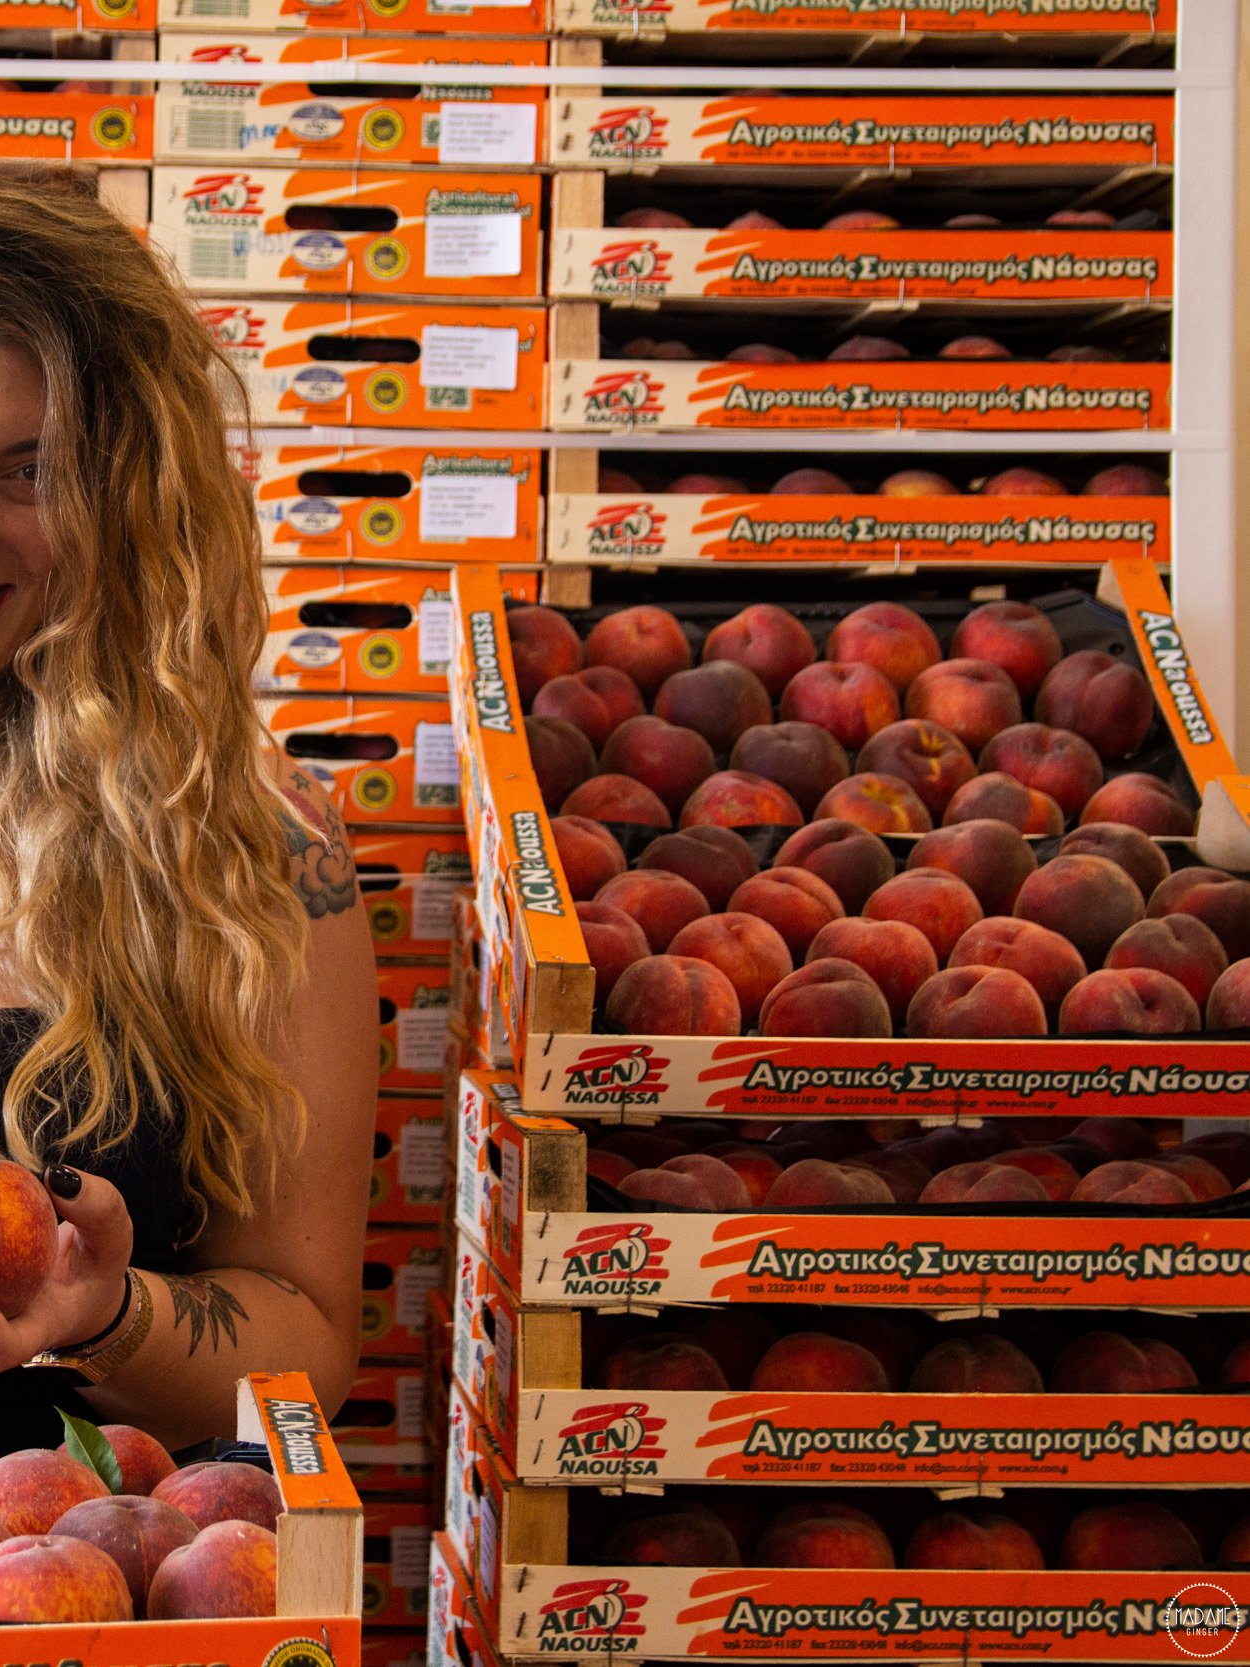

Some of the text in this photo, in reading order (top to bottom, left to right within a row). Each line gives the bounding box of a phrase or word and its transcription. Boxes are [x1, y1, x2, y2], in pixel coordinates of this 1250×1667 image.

[728, 117, 1154, 148] Αγροτικός Συνεταιρισμός Νάουσας
[733, 254, 1158, 284] Αγροτικός Συνεταιρισμός Νάουσας
[723, 385, 1150, 414] Αγροτικός Συνεταιρισμός Νάουσας
[728, 516, 1155, 546] Αγροτικός Συνεταιρισμός Νάουσας
[1137, 609, 1215, 745] ACNaoussa
[512, 810, 565, 916] ACNaoussa
[563, 1061, 635, 1092] ACN
[743, 1059, 904, 1095] Αγροτικός
[905, 1061, 1126, 1097] Συνεταιρισμός
[564, 1090, 660, 1105] NAOUSSA
[561, 1247, 634, 1281] ACN
[747, 1240, 913, 1285] Αγροτικός
[913, 1242, 1139, 1283] Συνεταιρισμός
[563, 1280, 662, 1296] NAOUSSA
[264, 1399, 326, 1475] ACNaoussa
[556, 1425, 629, 1461] ACN
[743, 1420, 910, 1459] Αγροτικός
[910, 1420, 1137, 1460] Συνεταιρισμός
[558, 1460, 659, 1476] NAOUSSA
[537, 1601, 611, 1638] ACN
[724, 1597, 891, 1637] Αγροτικός
[890, 1597, 1120, 1638] Συνεταιρισμός
[539, 1637, 639, 1653] NAOUSSA
